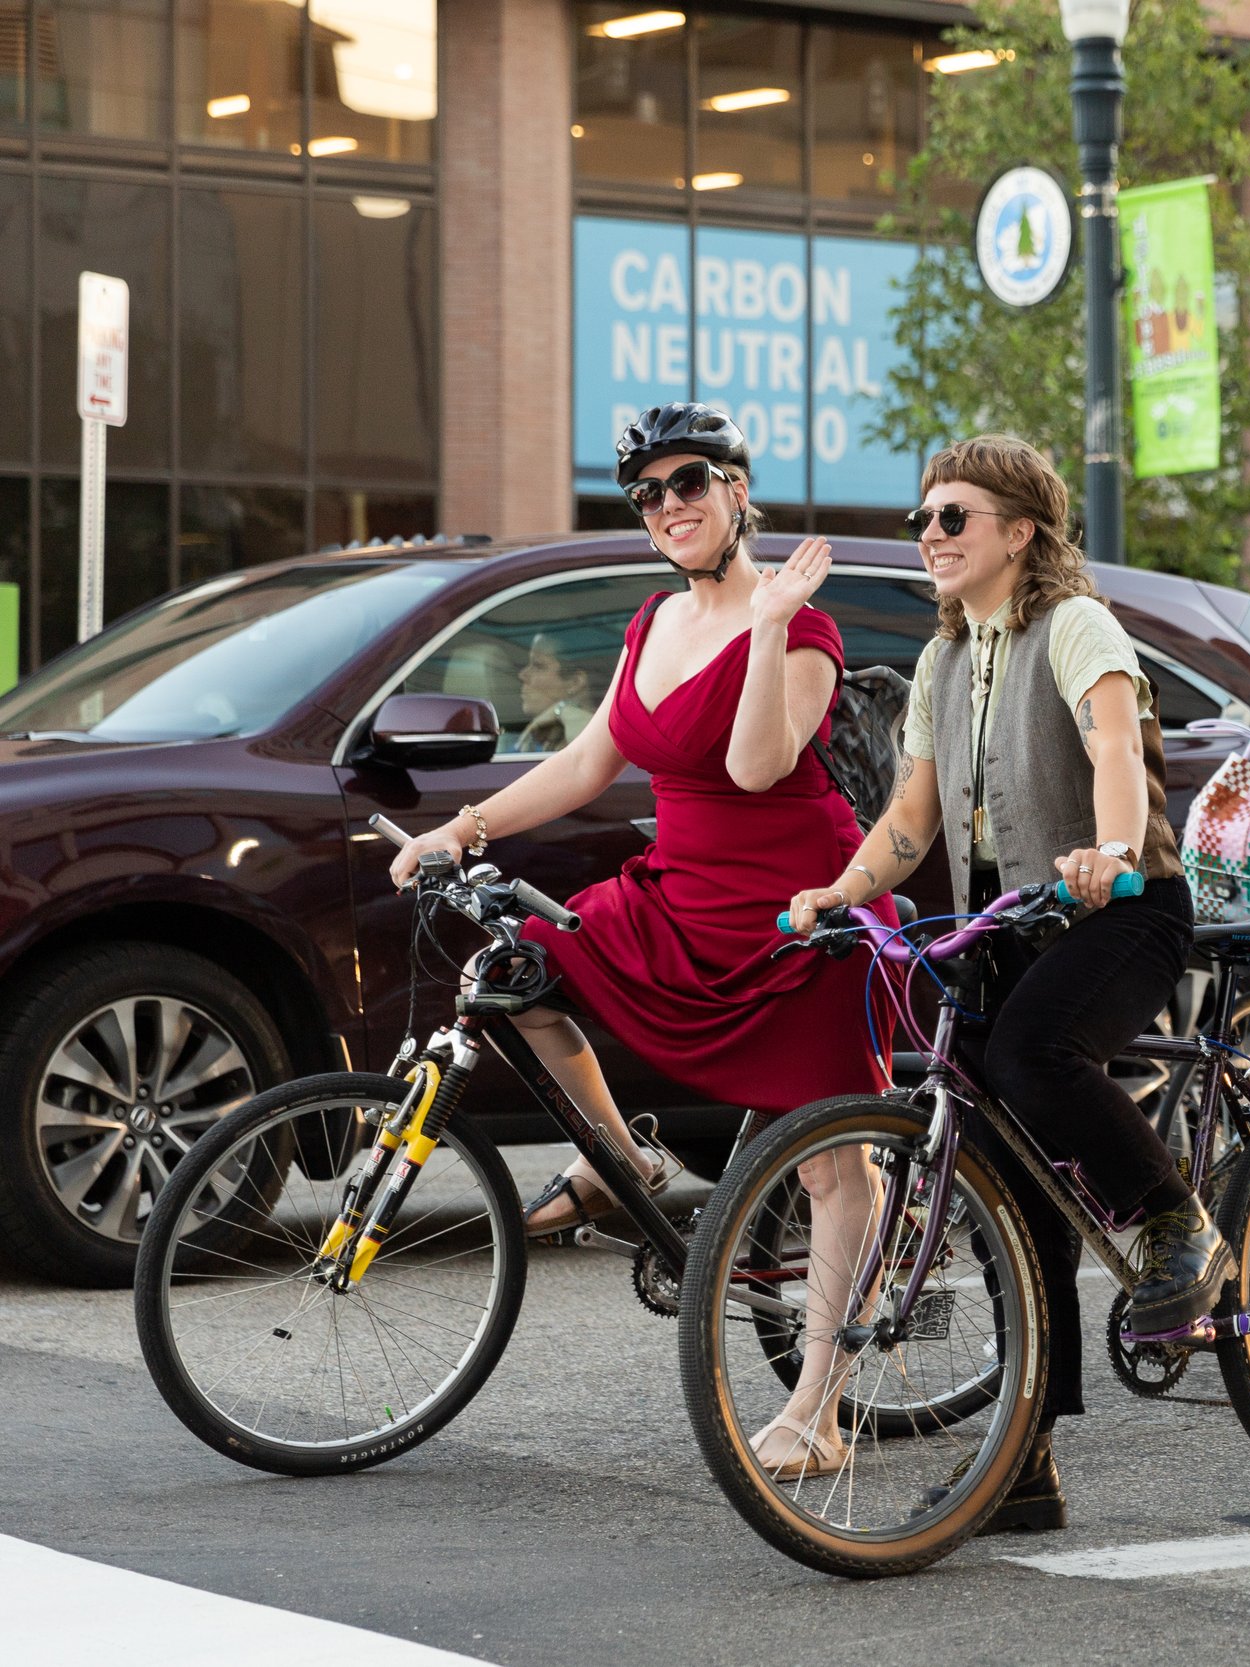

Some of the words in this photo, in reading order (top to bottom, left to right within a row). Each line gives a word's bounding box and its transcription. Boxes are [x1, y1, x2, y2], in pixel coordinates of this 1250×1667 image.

[612, 251, 850, 325] CARBON
[613, 321, 880, 396] NEUTRAL
[707, 399, 848, 464] 050
[536, 1070, 600, 1153] TREK
[1012, 1238, 1029, 1280] GRAVELKING
[340, 1424, 424, 1463] BONTRAGER
